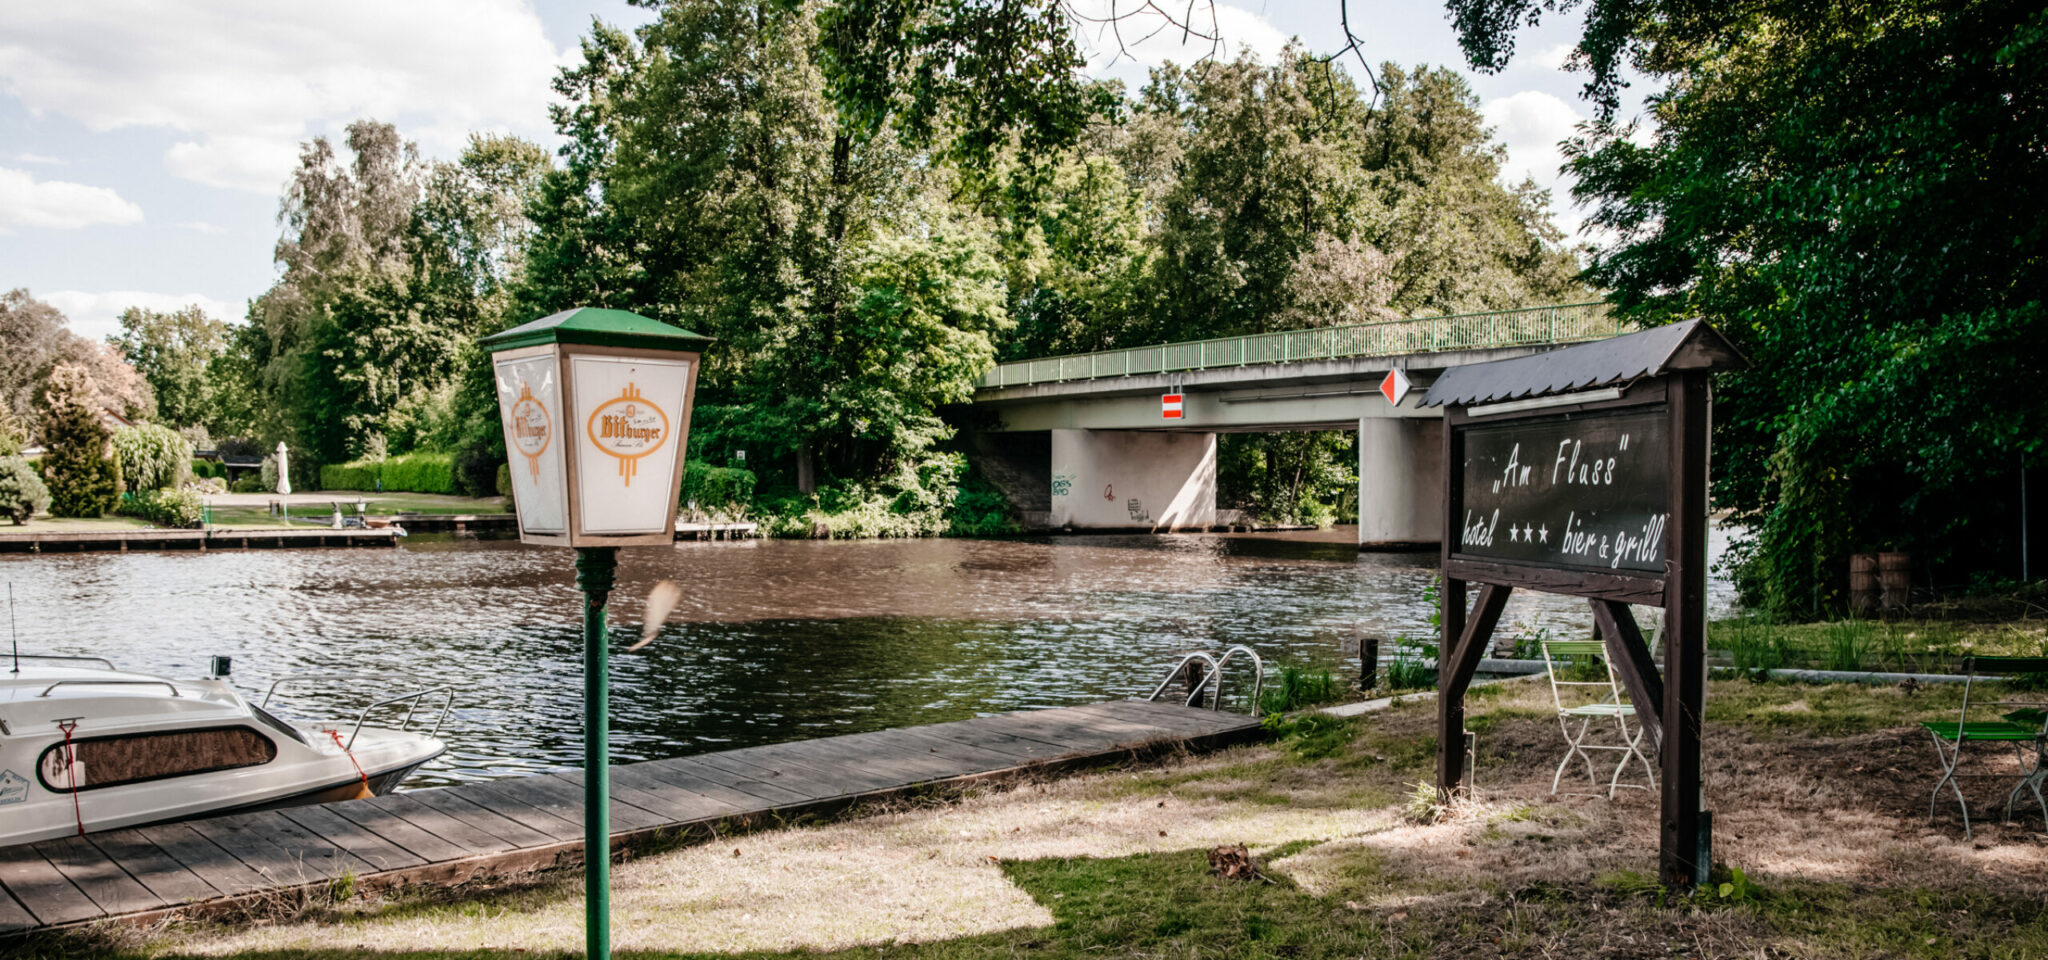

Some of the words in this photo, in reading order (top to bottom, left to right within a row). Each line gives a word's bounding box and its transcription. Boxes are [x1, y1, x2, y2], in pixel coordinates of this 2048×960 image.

[600, 415, 660, 442] Bitburger
[1461, 508, 1499, 547] hotel
[1562, 511, 1596, 554] bier
[1599, 535, 1609, 559] &
[1611, 514, 1664, 568] grill
